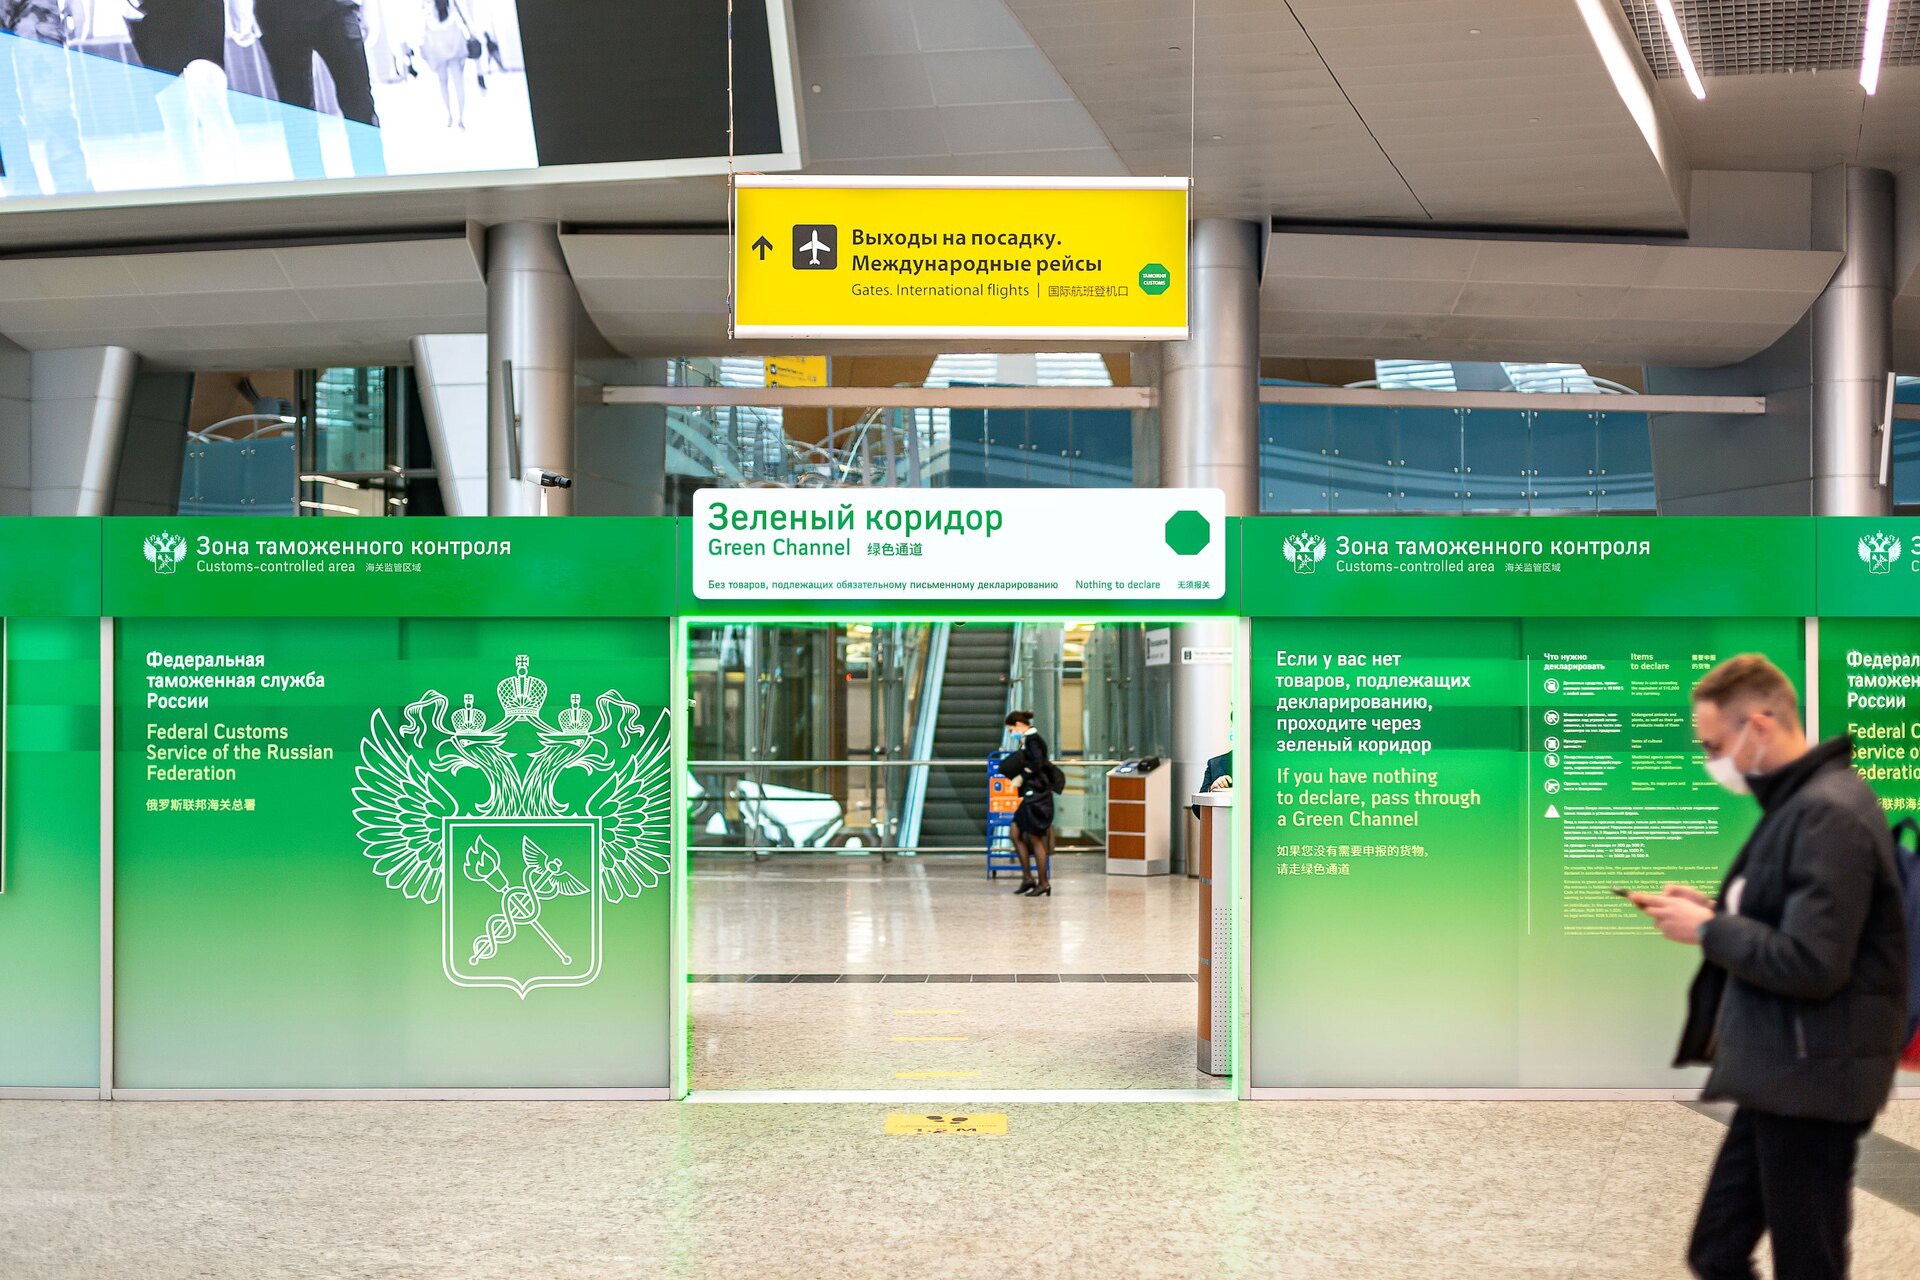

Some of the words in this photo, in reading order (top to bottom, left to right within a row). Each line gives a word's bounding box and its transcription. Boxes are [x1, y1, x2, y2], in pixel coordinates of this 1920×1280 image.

[852, 229, 937, 248] Выходы
[943, 233, 966, 245] на
[972, 233, 1061, 250] посадку.
[852, 255, 1031, 276] Международные
[1037, 255, 1102, 276] рейсы
[852, 284, 892, 296] Gates.
[897, 284, 983, 296] International
[987, 283, 1030, 300] flights
[1048, 286, 1128, 297] 国际航班登机口
[708, 502, 854, 530] Зеленый
[866, 510, 1002, 538] коридор
[196, 536, 249, 555] Зона
[256, 541, 403, 556] таможенного
[412, 541, 510, 560] контроля
[708, 538, 765, 556] Green
[773, 538, 850, 556] Channel
[867, 542, 922, 556] 绿色通道
[1336, 536, 1388, 555] Зона
[1395, 541, 1542, 555] таможенного
[1551, 541, 1650, 560] контроля
[197, 560, 324, 572] Customs-controlled
[328, 562, 355, 572] area
[366, 562, 422, 572] 海关监管区域
[1336, 560, 1464, 572] Customs-controlled
[1468, 562, 1494, 572] area
[1505, 562, 1561, 572] 海关监管区域
[708, 580, 726, 589] Без
[728, 582, 768, 590] товаров,
[772, 582, 833, 590] подлежащих
[836, 580, 907, 591] обязательному
[910, 582, 975, 591] письменному
[977, 582, 1058, 591] декларированию
[1076, 580, 1112, 591] Nothing
[1115, 581, 1125, 589] to
[1128, 580, 1160, 589] declare
[146, 651, 264, 672] Федеральная
[1277, 650, 1317, 666] Если
[1322, 654, 1332, 670] у
[1338, 654, 1366, 666] вас
[1372, 654, 1402, 666] нет
[1544, 664, 1605, 672] декларировать
[146, 675, 255, 688] таможенная
[260, 670, 325, 692] служба
[1275, 676, 1350, 692] товаров,
[1356, 676, 1470, 690] подлежащих
[147, 692, 208, 709] России
[1276, 697, 1432, 713] декларированию,
[1847, 692, 1906, 708] России
[147, 722, 208, 740] Federal
[214, 723, 288, 739] Customs
[1277, 718, 1367, 734] проходите
[1372, 718, 1421, 734] через
[1848, 722, 1905, 739] Federal
[146, 744, 207, 760] Service
[212, 744, 230, 760] of
[233, 744, 261, 760] the
[268, 744, 333, 760] Russian
[1277, 736, 1352, 752] зеленый
[1358, 740, 1432, 756] коридор
[1910, 747, 1920, 759] o
[147, 764, 236, 780] Federation
[1278, 768, 1290, 784] If
[1294, 772, 1323, 787] you
[1329, 768, 1367, 784] have
[1373, 767, 1438, 788] nothing
[146, 798, 256, 811] 俄罗斯联邦海关总署
[1276, 791, 1293, 805] to
[1299, 789, 1365, 808] declare,
[1372, 793, 1409, 808] pass
[1414, 789, 1480, 809] through
[1878, 798, 1920, 810] 联邦海
[1278, 815, 1286, 826] a
[1293, 810, 1343, 826] Green
[1350, 810, 1418, 826] Channel
[1277, 863, 1350, 875] 请走绿色通道
